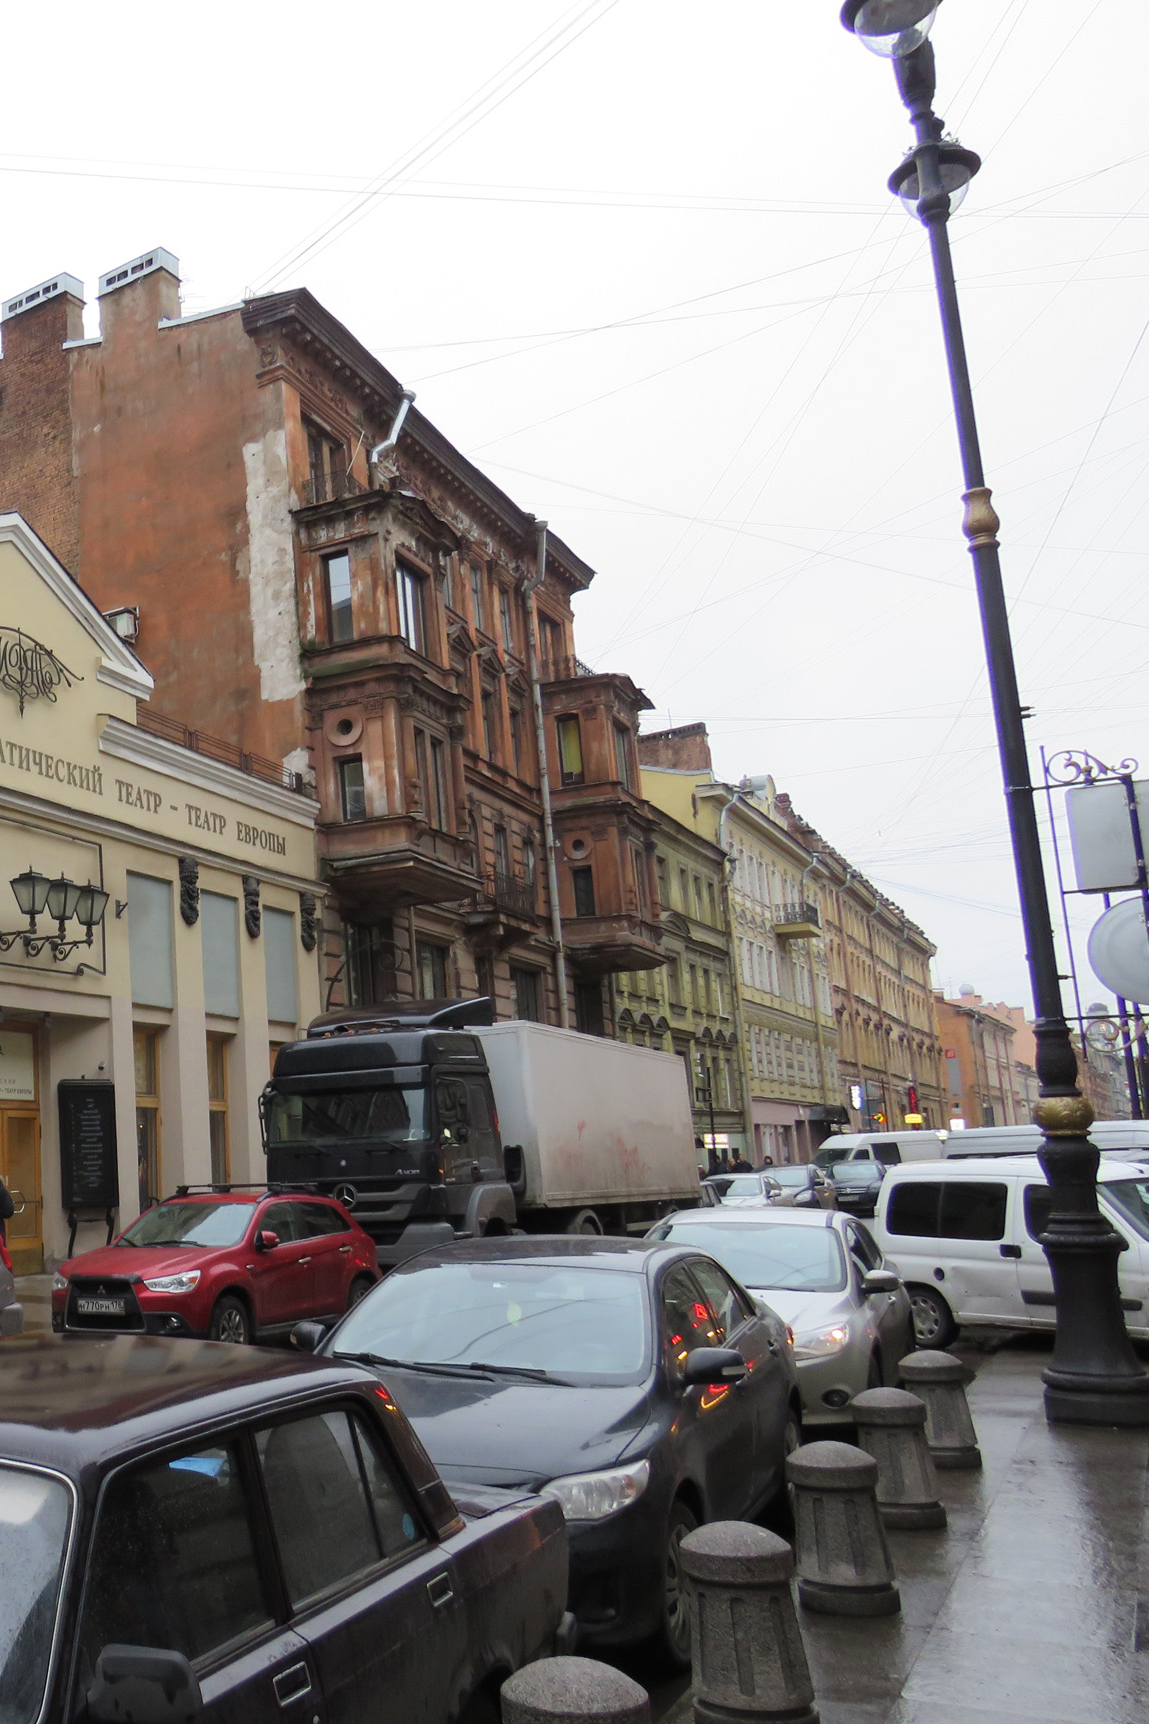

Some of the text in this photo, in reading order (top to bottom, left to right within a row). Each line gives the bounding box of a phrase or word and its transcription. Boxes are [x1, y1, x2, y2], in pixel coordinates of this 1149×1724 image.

[115, 779, 162, 814] ТЕАТР
[185, 804, 226, 835] ТЕАТР
[236, 820, 286, 856] ЕВРОПЫ
